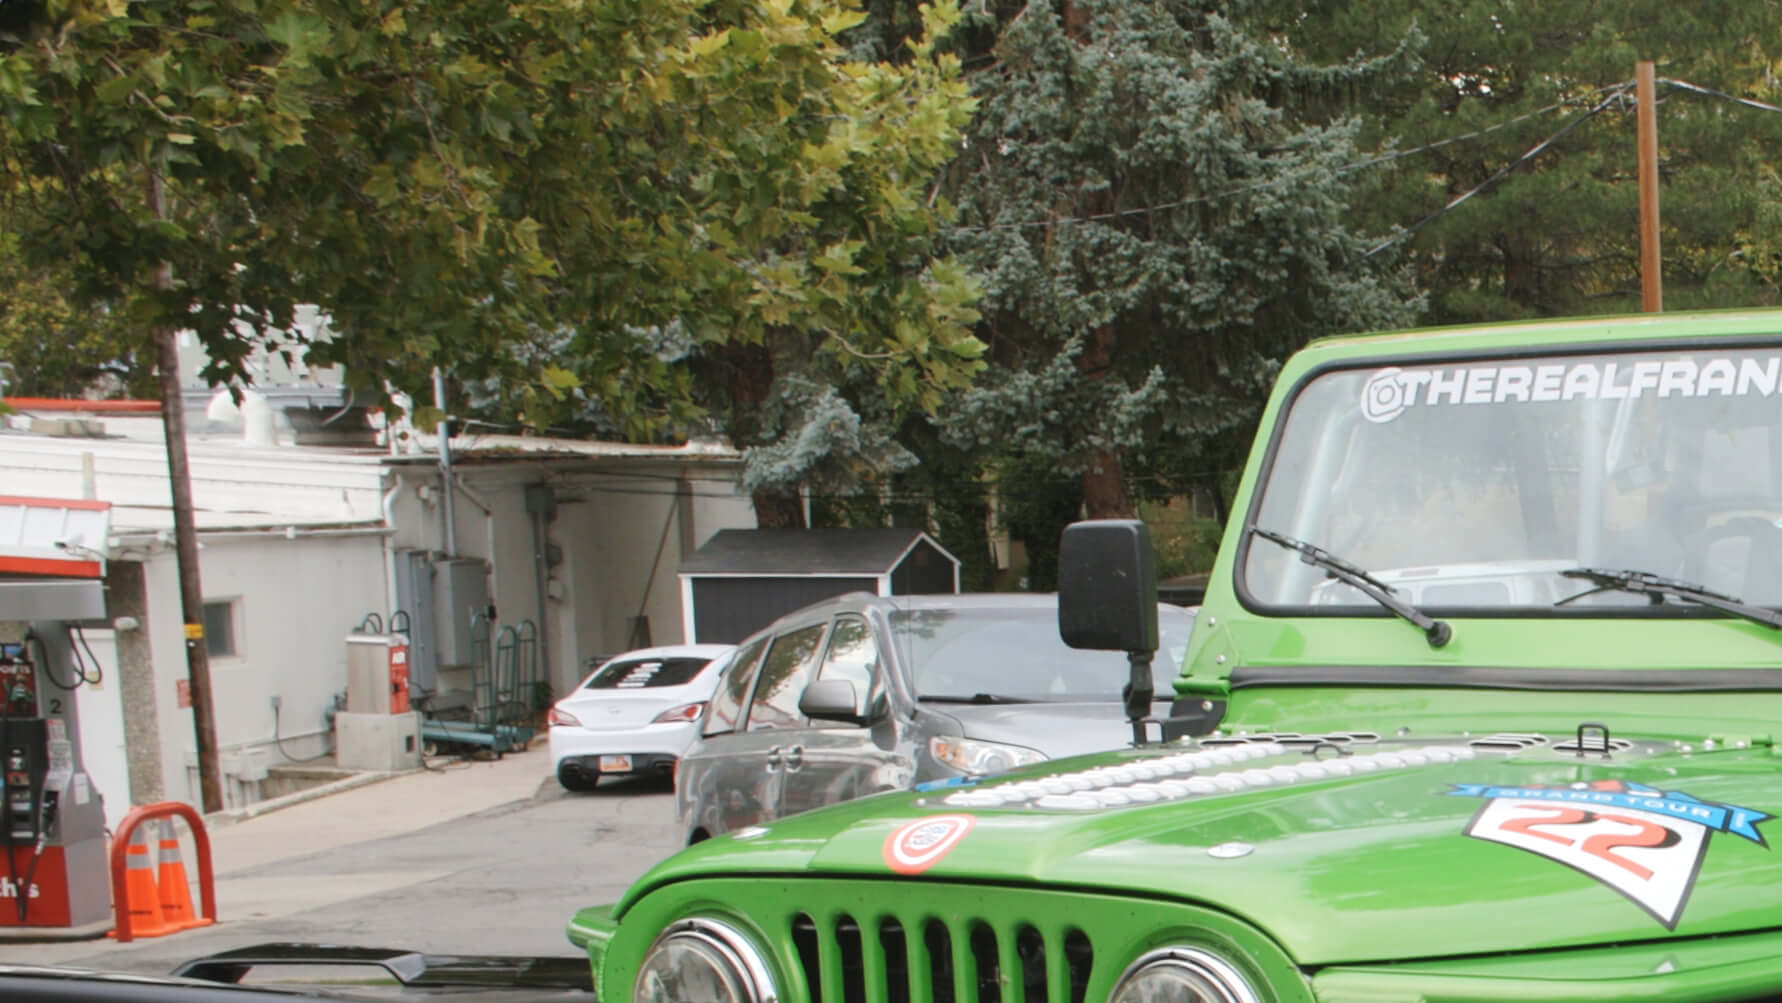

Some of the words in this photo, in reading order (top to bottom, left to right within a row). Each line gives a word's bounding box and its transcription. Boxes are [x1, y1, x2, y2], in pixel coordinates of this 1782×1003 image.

[50, 699, 63, 714] 2
[1628, 796, 1711, 818] TOUR
[1499, 804, 1682, 881] 22
